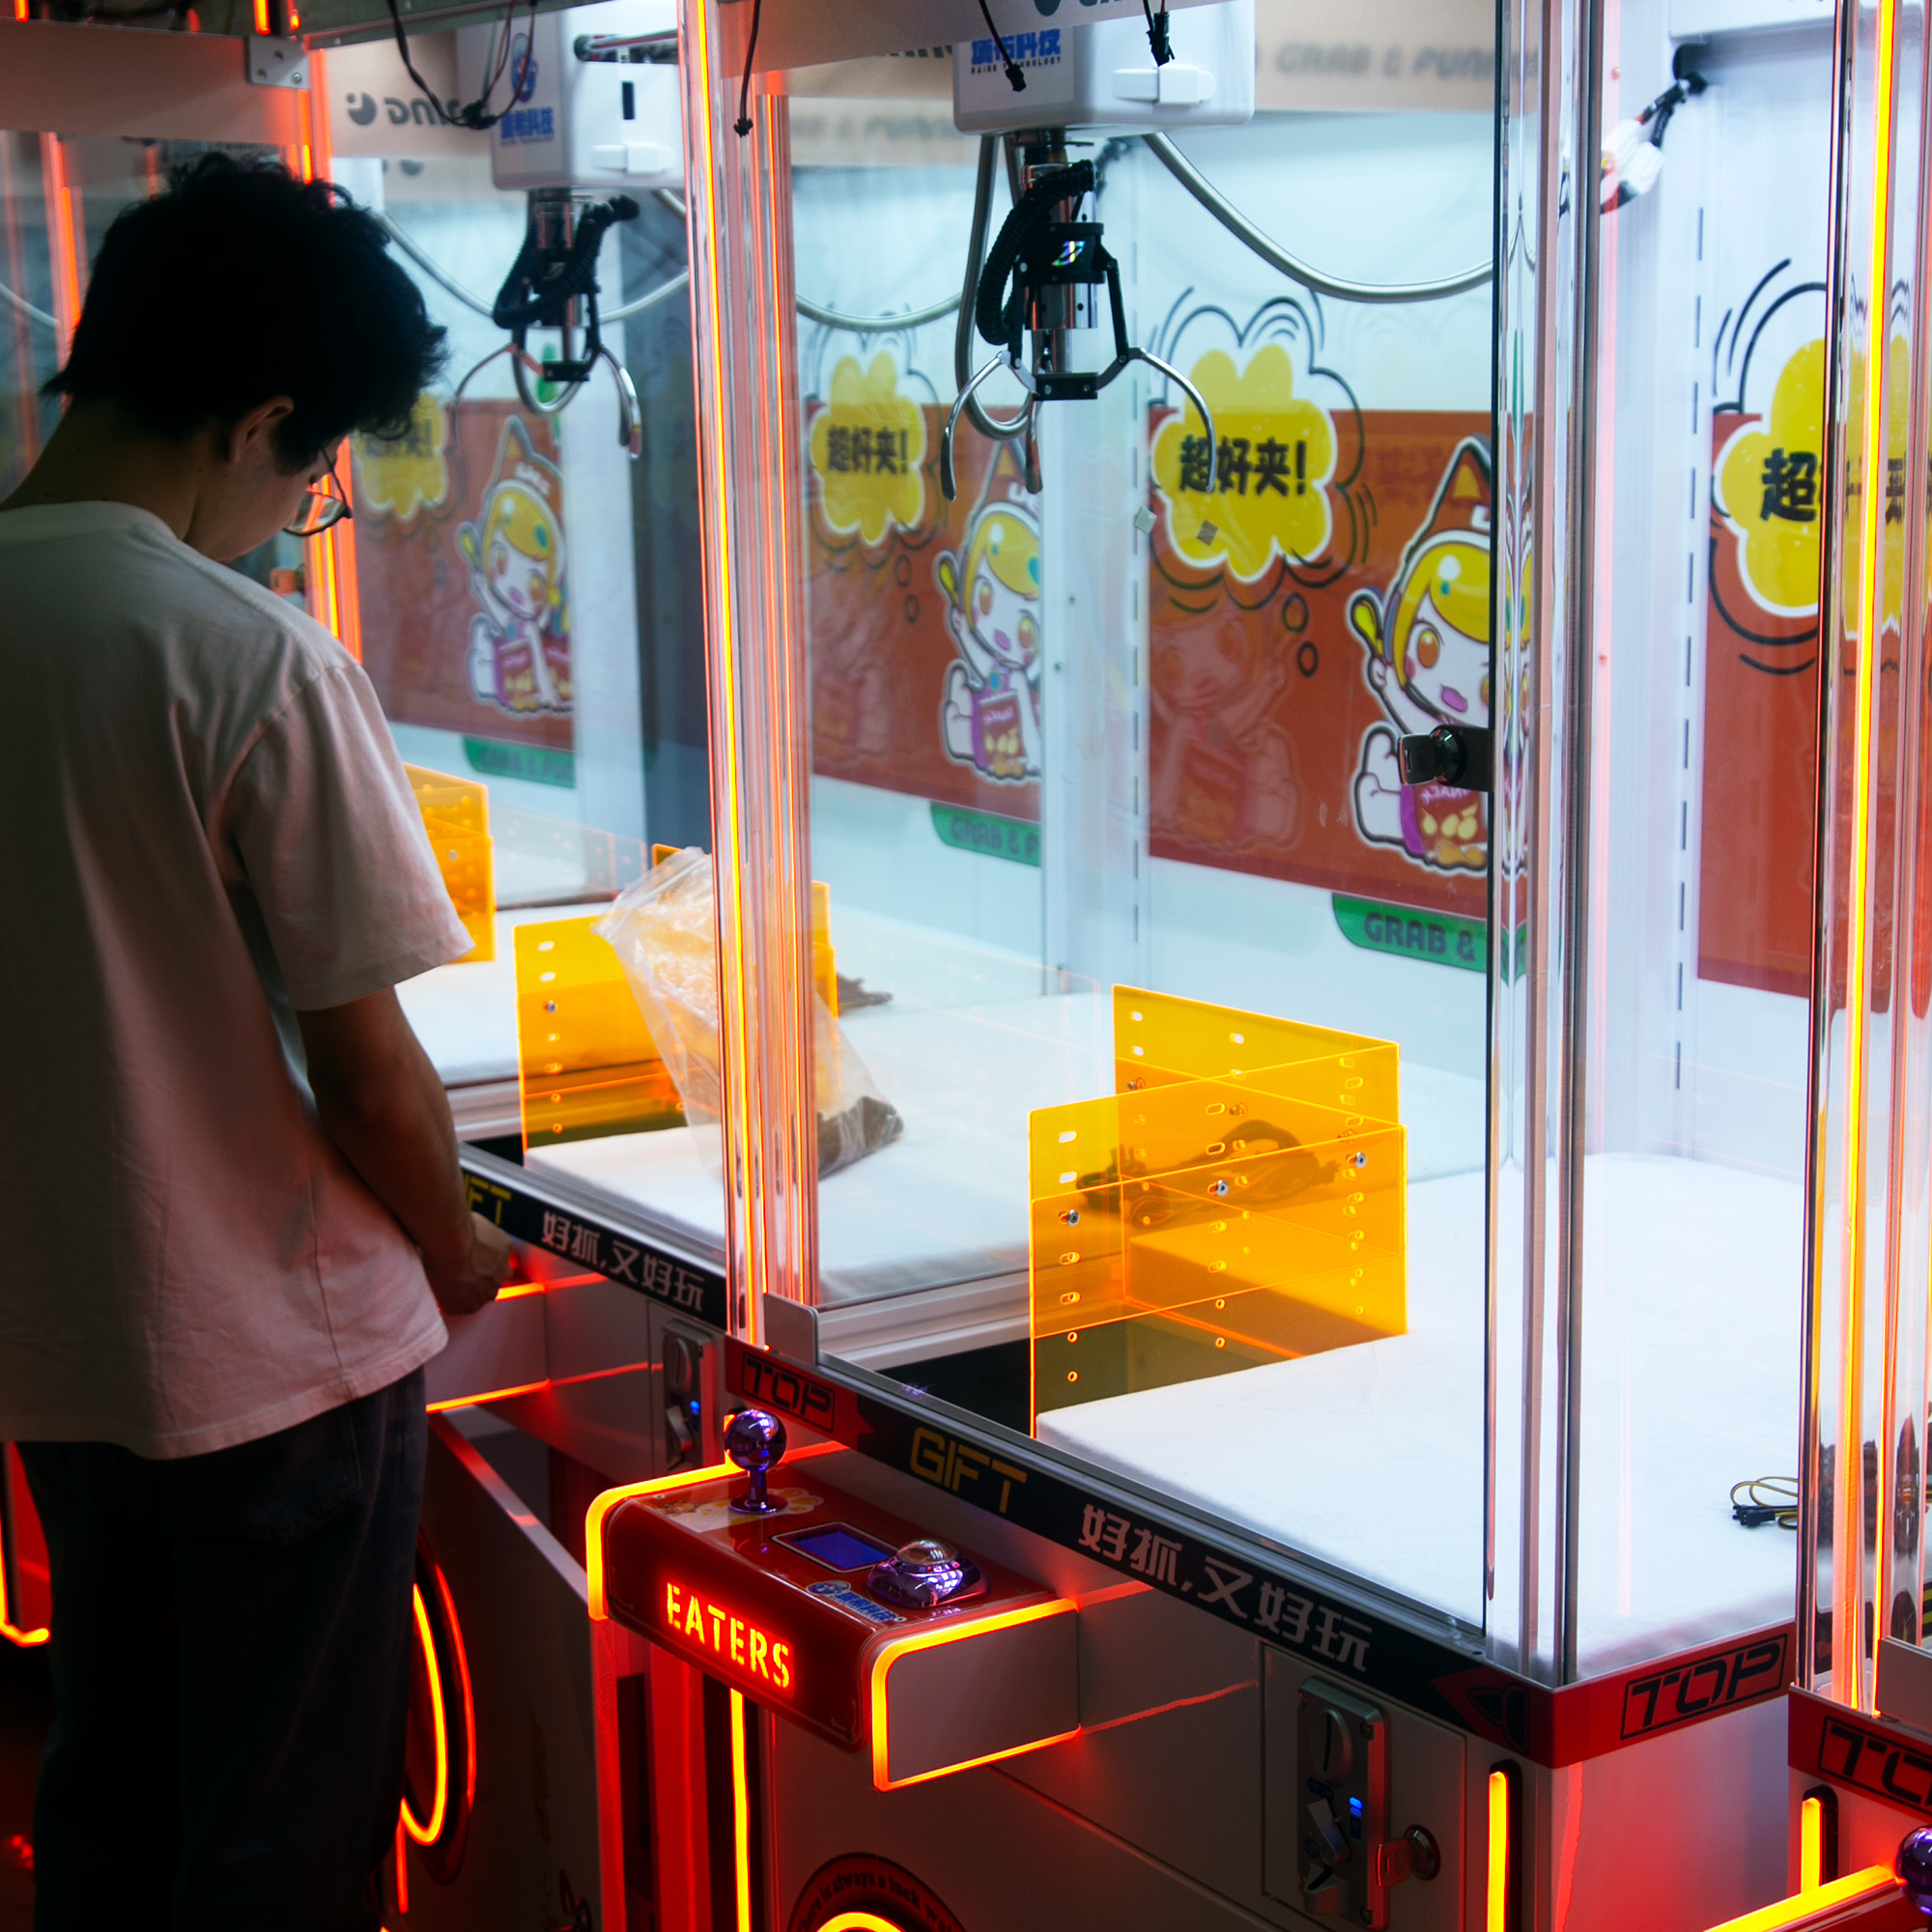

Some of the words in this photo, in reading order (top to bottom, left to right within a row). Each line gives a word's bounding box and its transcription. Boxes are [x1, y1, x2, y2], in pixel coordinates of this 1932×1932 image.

[971, 64, 997, 74] RAISE
[1003, 55, 1061, 71] THNOLOGY
[827, 423, 908, 475] 超好夹!
[1179, 434, 1307, 498] 超好夹!
[1364, 911, 1448, 955] GRAB
[1456, 929, 1476, 962] &
[464, 1173, 513, 1226] IFT
[747, 1356, 833, 1417] TOP
[910, 1426, 1028, 1515] GIFT
[667, 1581, 789, 1689] EATERS
[1632, 1642, 1780, 1728] TOP
[832, 1870, 876, 1893] always
[878, 1876, 887, 1889] a
[889, 1874, 922, 1910] luck
